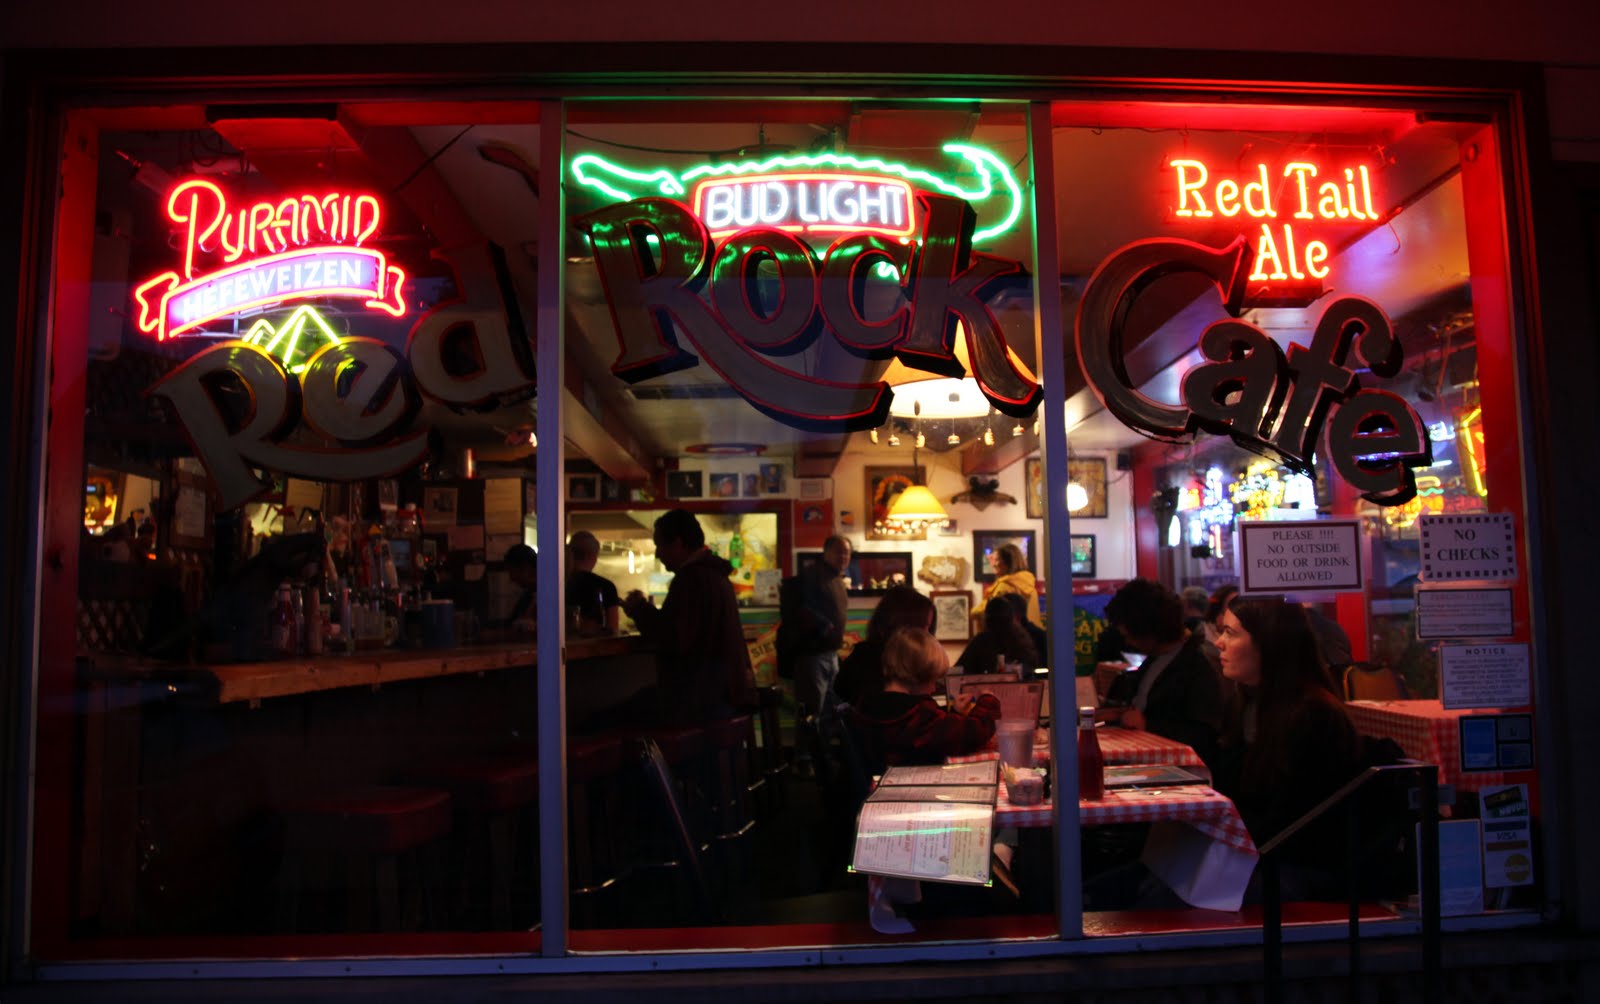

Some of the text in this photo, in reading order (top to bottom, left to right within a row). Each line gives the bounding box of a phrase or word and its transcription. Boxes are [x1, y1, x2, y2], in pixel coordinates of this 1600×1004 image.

[1169, 158, 1380, 220] Red Tail
[708, 180, 906, 229] BUD LIGHT
[167, 180, 381, 279] PYRAMID
[1250, 223, 1331, 283] Ale
[182, 258, 363, 323] HEFEWEIZEN
[146, 190, 1432, 507] Red Rock Cafe
[1272, 530, 1314, 541] PLEASE
[1454, 528, 1476, 542] NO
[1267, 543, 1342, 554] NO OUTSIDE
[1437, 547, 1500, 562] CHECKS
[1257, 556, 1351, 568] FOOD OR DRINK
[1277, 571, 1333, 582] ALLOWED
[1465, 647, 1507, 656] NOTICE
[1496, 831, 1518, 841] VISA
